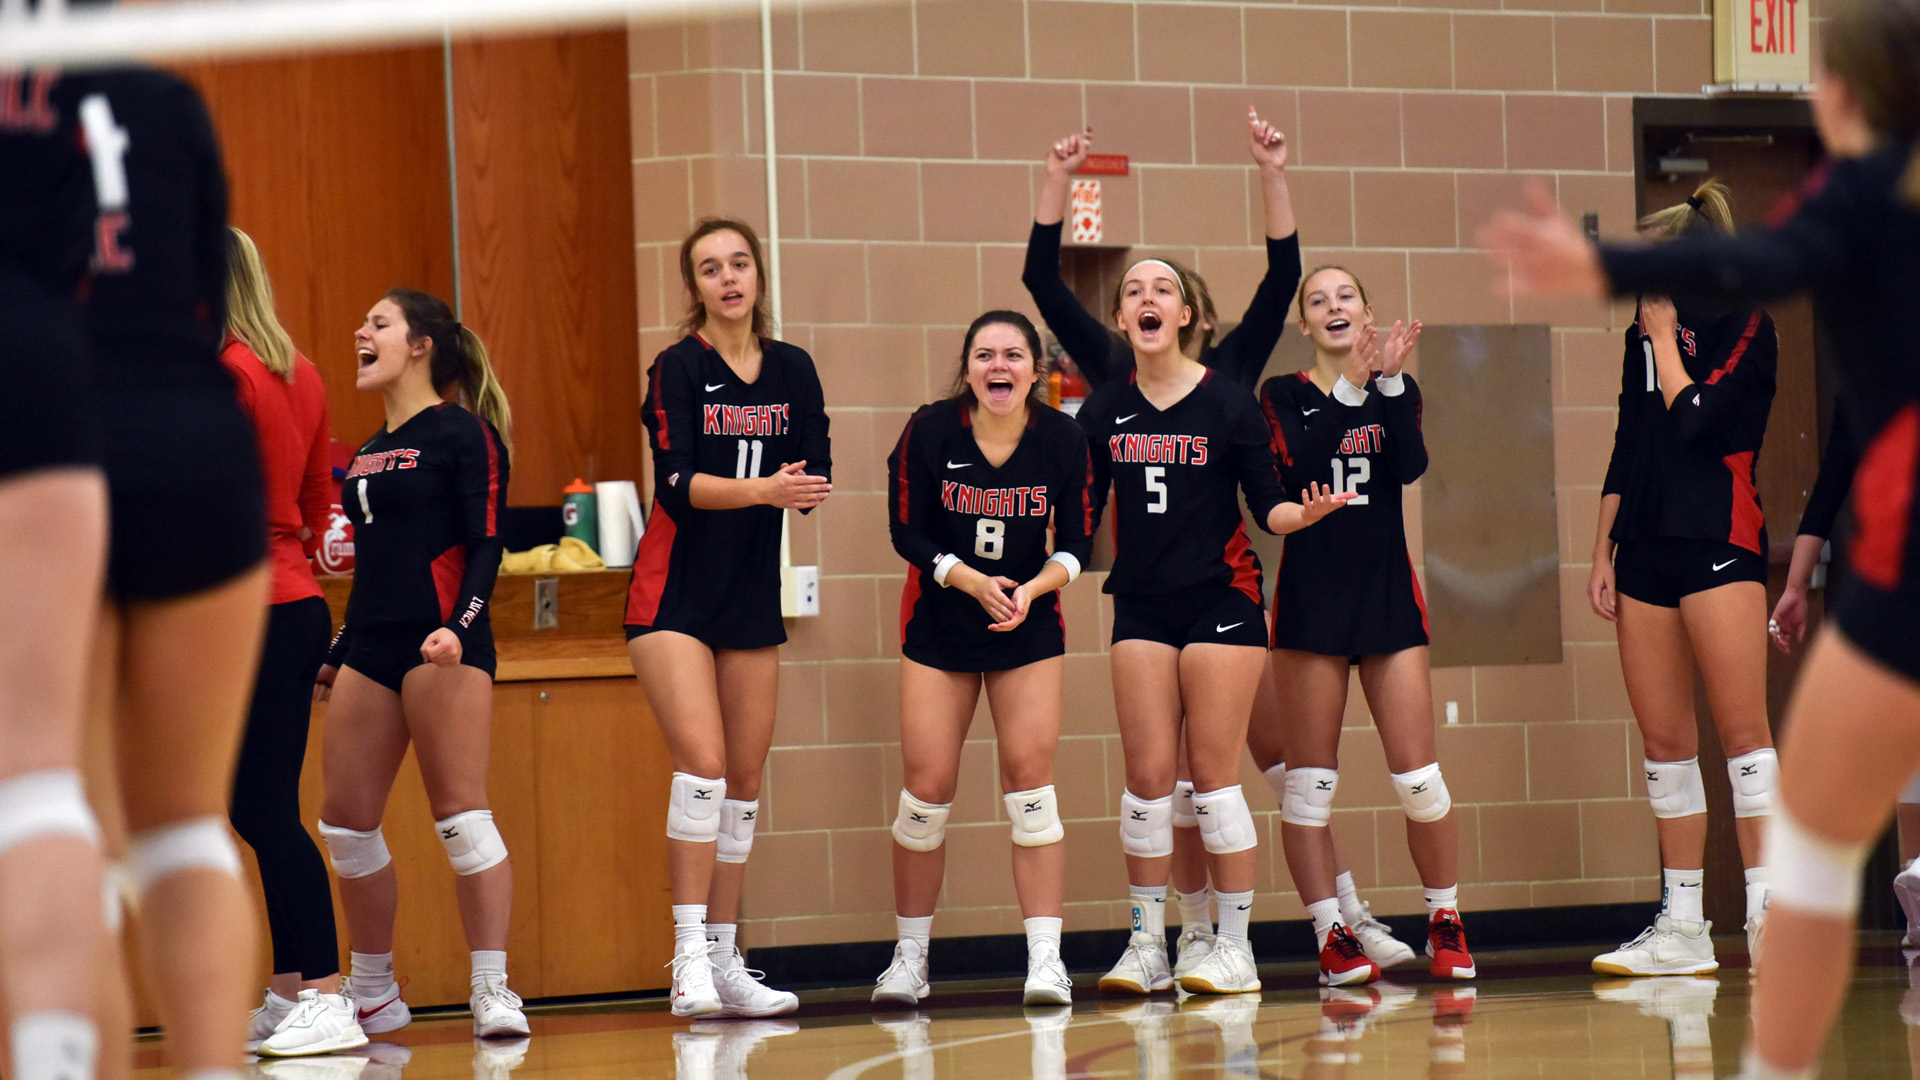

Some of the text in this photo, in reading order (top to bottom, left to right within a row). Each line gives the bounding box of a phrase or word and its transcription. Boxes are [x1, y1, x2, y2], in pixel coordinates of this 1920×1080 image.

[1750, 0, 1797, 54] EXIT
[736, 439, 763, 479] 11
[1108, 432, 1208, 465] KNIGHTS
[357, 478, 374, 524] 1
[941, 480, 1047, 517] KNIGHTS
[1145, 466, 1168, 514] 5
[1330, 457, 1370, 506] 12
[974, 518, 1005, 561] 8
